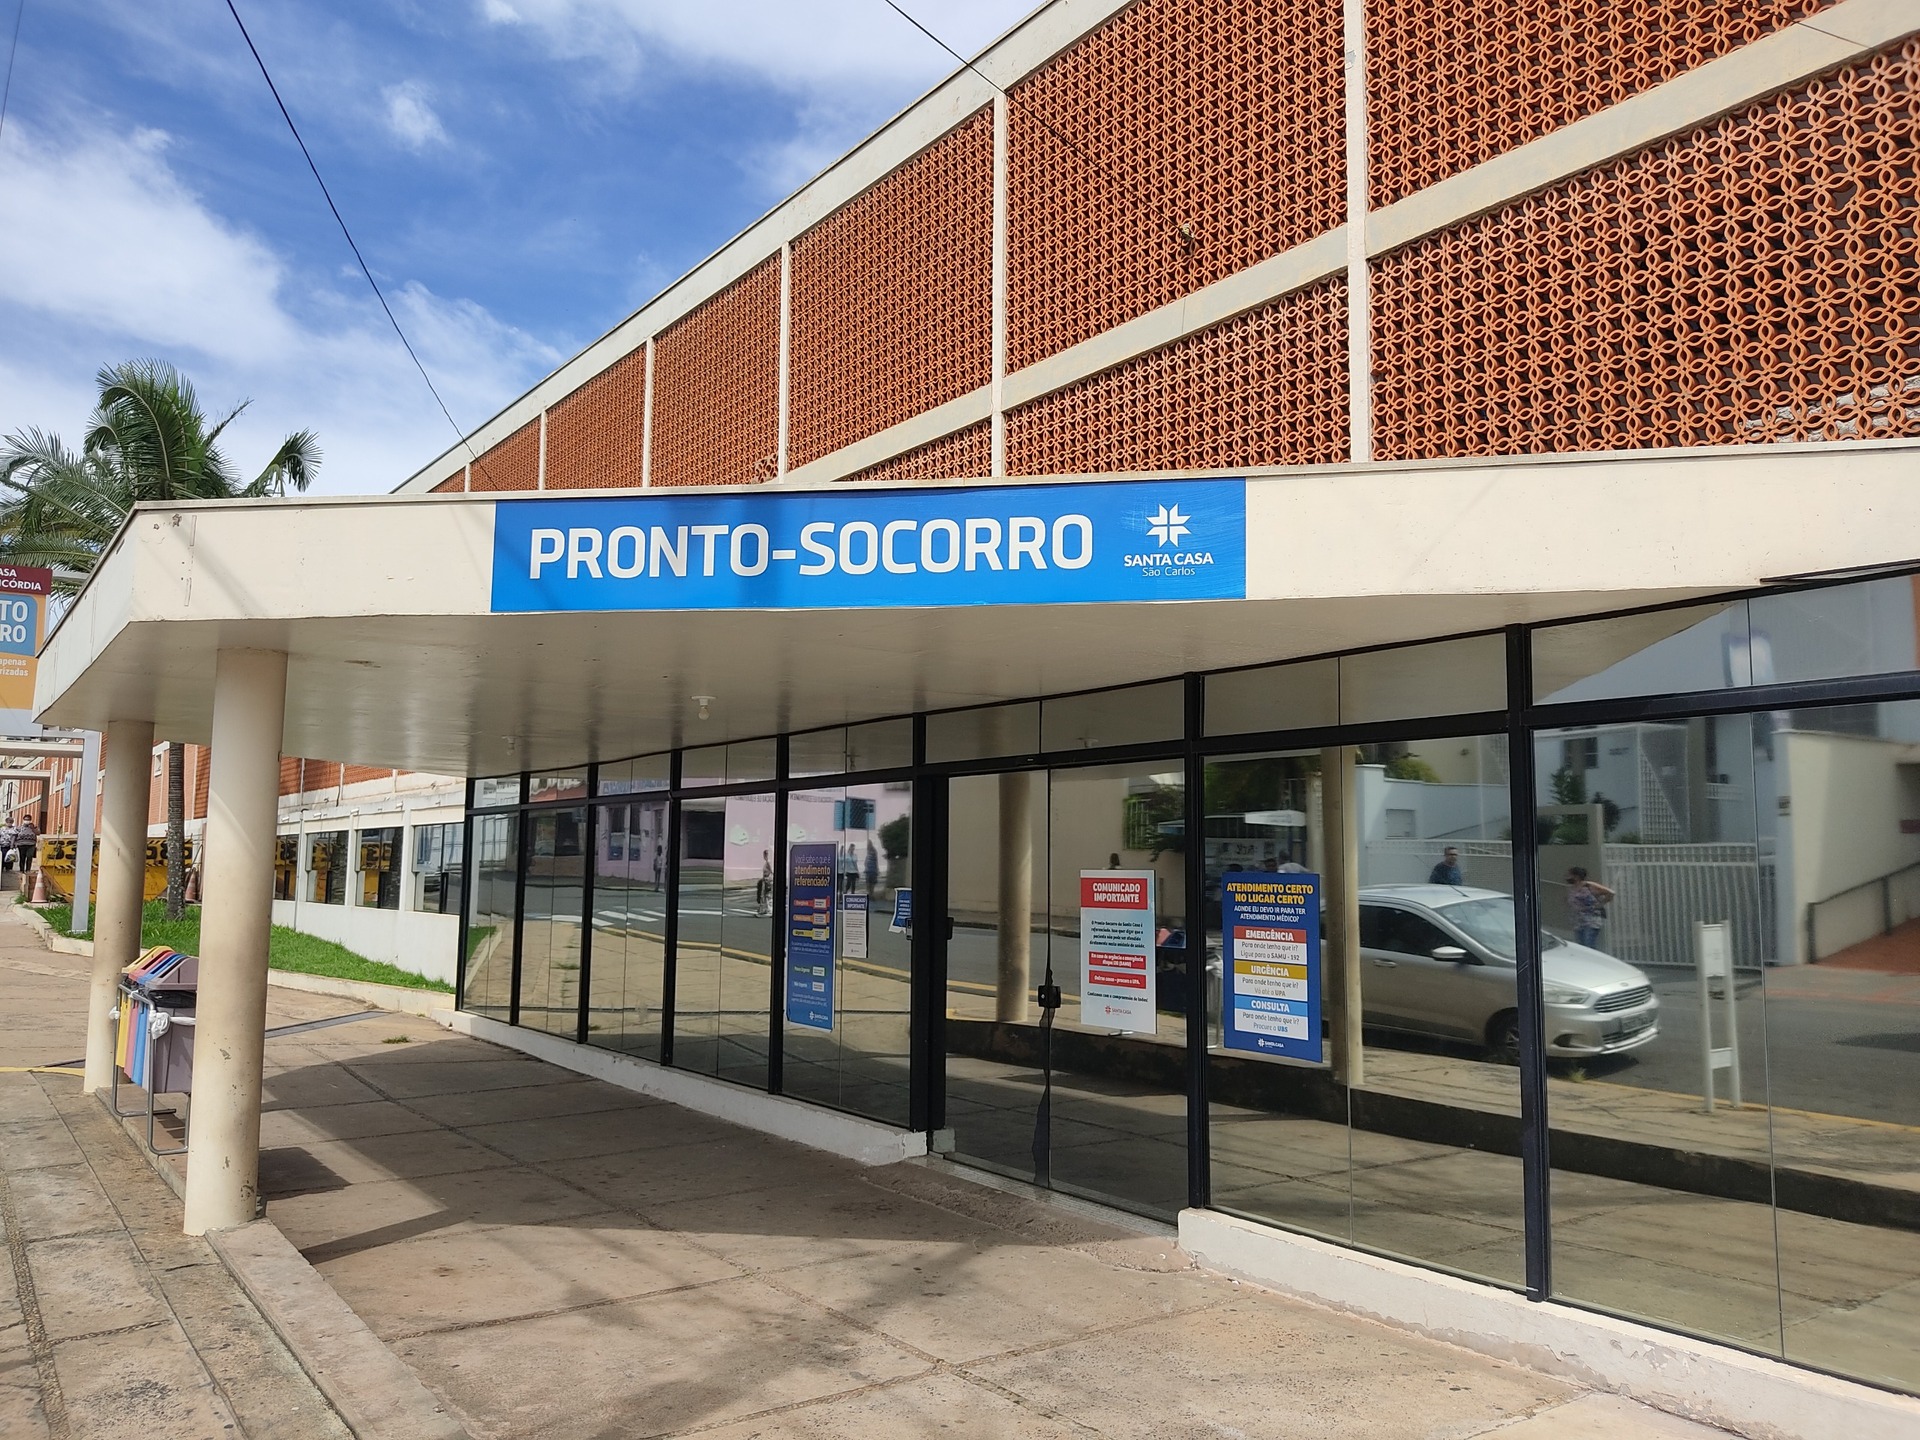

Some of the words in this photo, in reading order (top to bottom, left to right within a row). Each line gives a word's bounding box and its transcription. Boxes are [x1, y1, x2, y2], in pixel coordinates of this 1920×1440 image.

[529, 513, 1093, 580] PRONTO-SOCORRO
[1124, 553, 1172, 567] SANTA
[1173, 552, 1214, 565] CASA
[1142, 567, 1161, 576] São
[1164, 566, 1196, 576] Carlos
[0, 600, 28, 622] TO
[0, 623, 27, 643] RO
[794, 864, 830, 875] atendimento
[794, 876, 830, 886] referenciado?
[1092, 882, 1140, 892] COMUNICADO
[1226, 882, 1284, 893] ATENDIMENTO
[1285, 884, 1314, 894] CERTO
[1094, 892, 1140, 903] IMPORTANTE
[1235, 894, 1247, 902] NO
[1248, 894, 1276, 904] LUGAR
[1276, 894, 1305, 905] CERTO
[1276, 914, 1300, 923] MÉDICO?
[1245, 928, 1294, 941] EMERGÊNCIA
[1250, 964, 1289, 977] URGÊNCIA
[1251, 1000, 1290, 1013] CONSULTA
